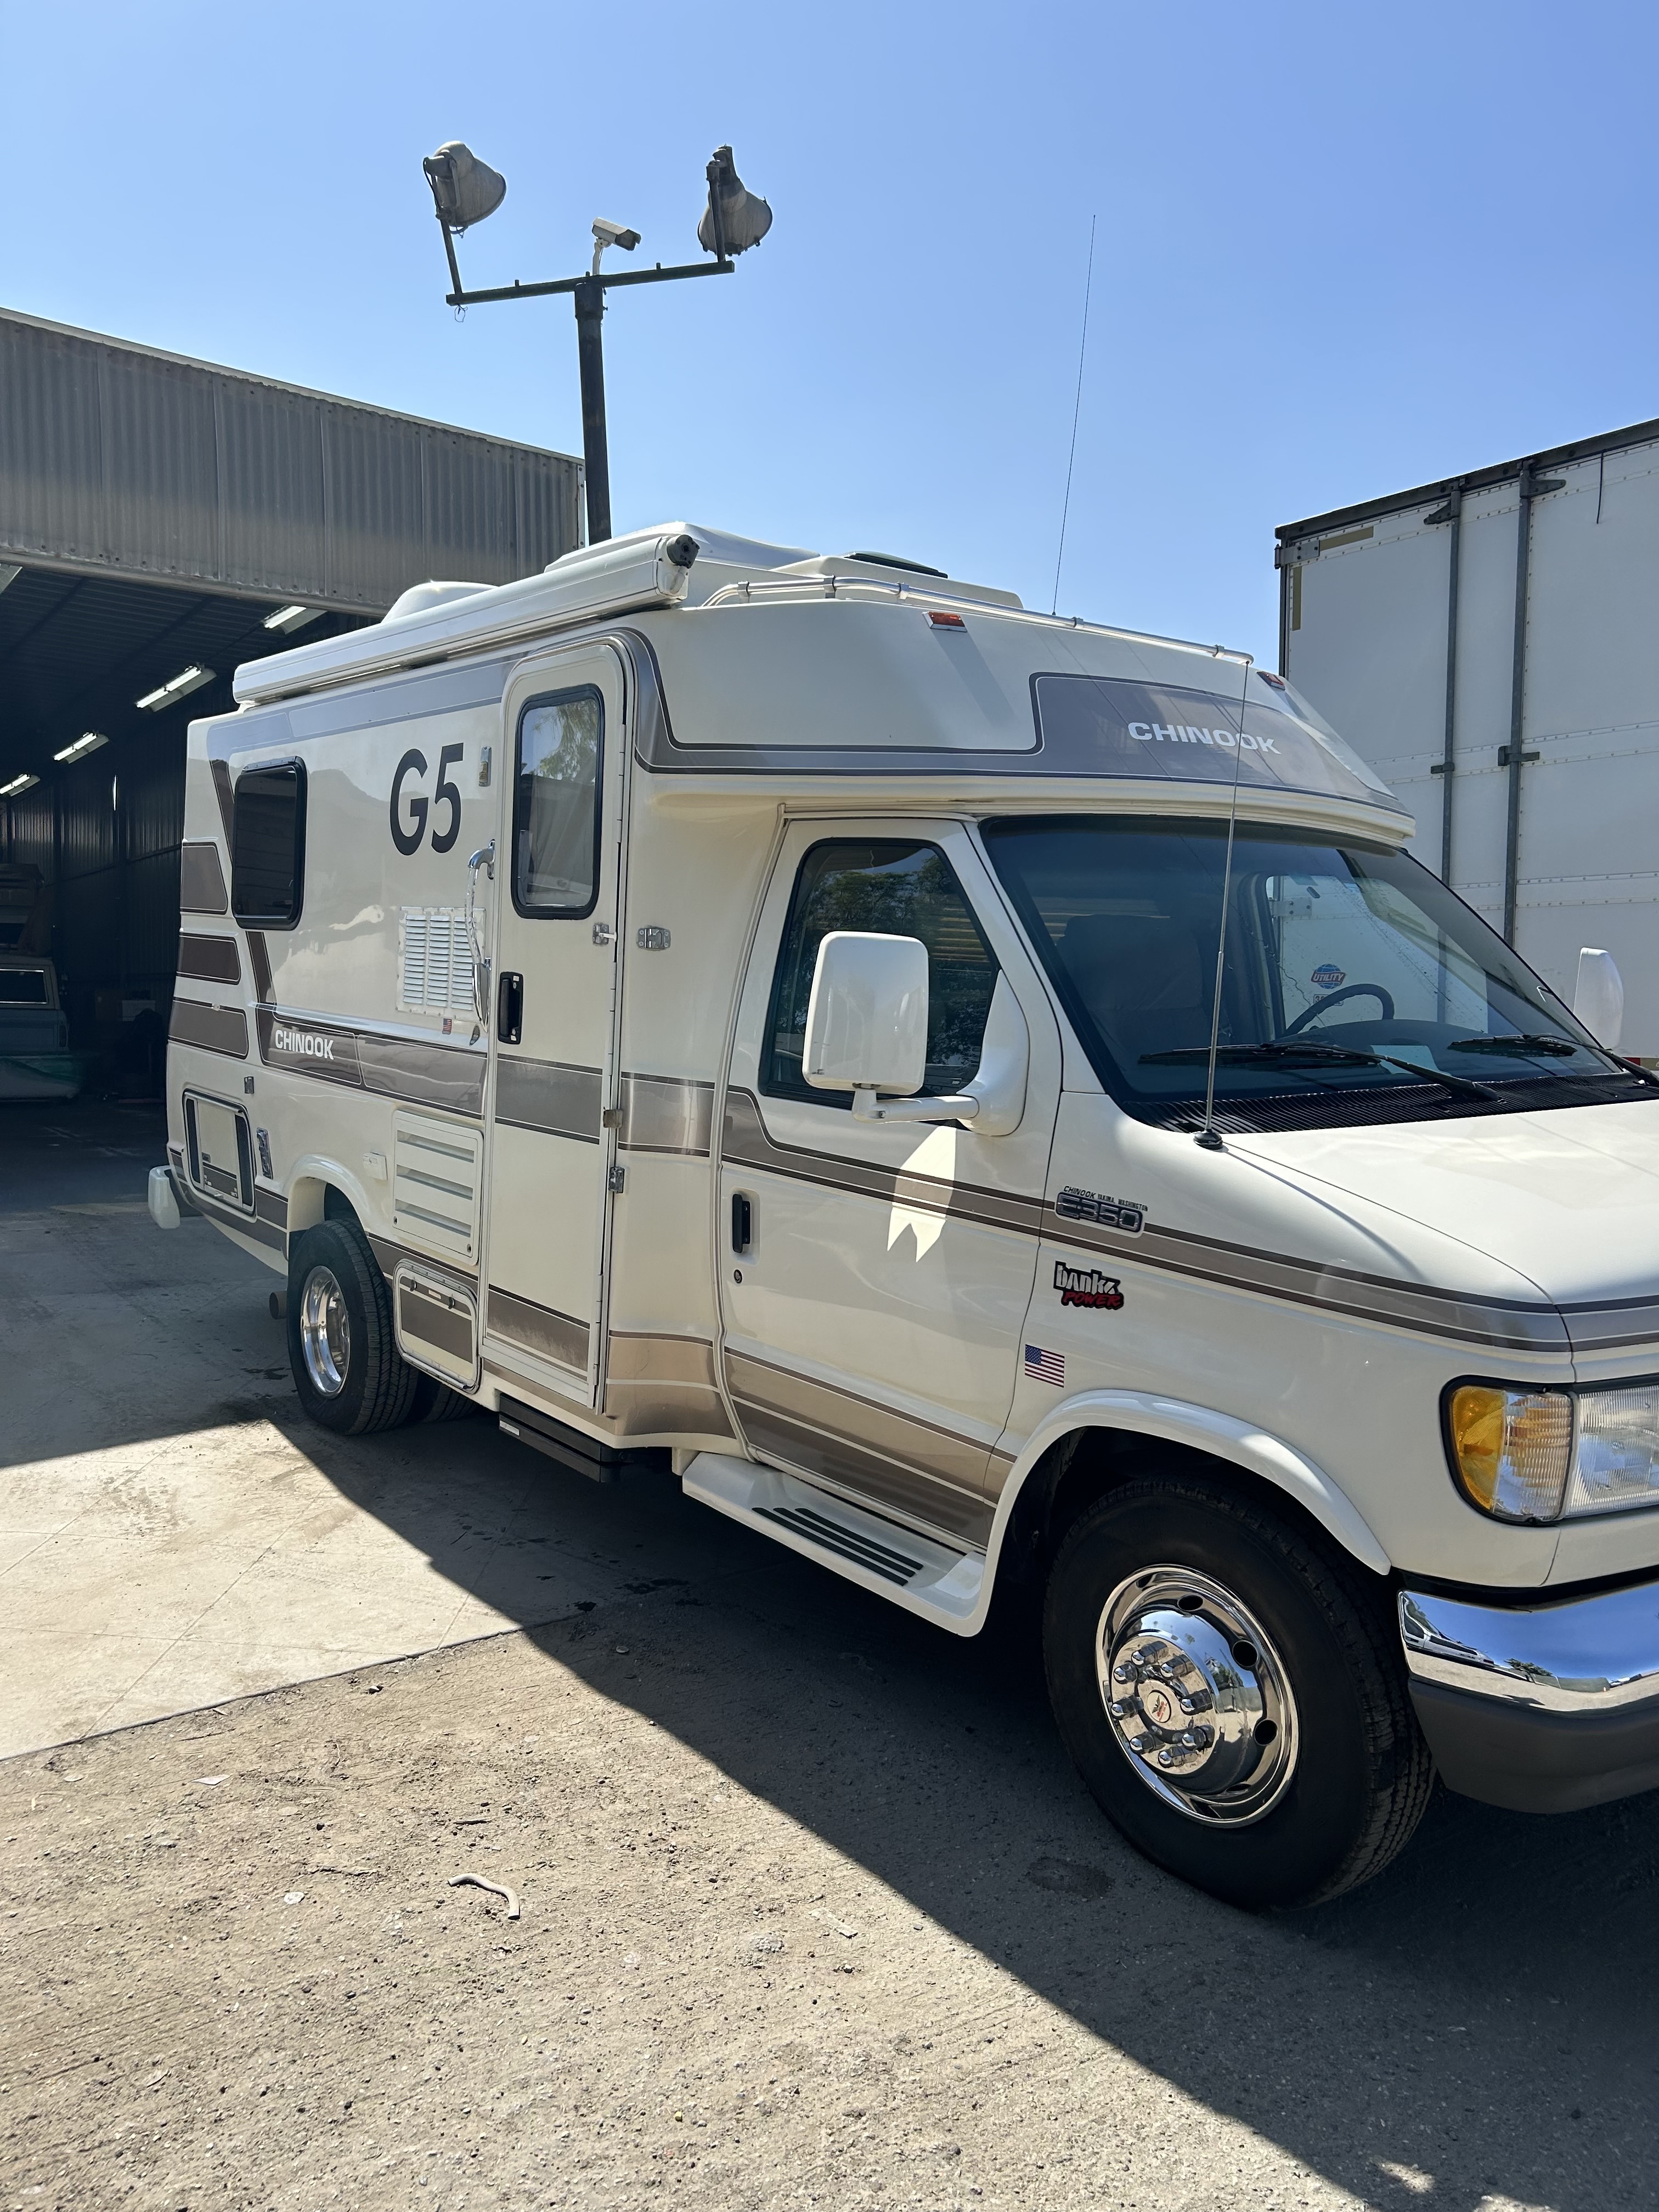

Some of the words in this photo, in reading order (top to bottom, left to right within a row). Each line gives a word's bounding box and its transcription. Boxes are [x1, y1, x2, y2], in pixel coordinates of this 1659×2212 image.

[1128, 722, 1282, 754] CHINOOK
[390, 742, 464, 856] G5
[1313, 973, 1344, 981] UTILITY
[275, 1029, 334, 1060] CHINOOK
[1063, 1186, 1097, 1199] CHINOOK
[1062, 1291, 1122, 1307] POWER
